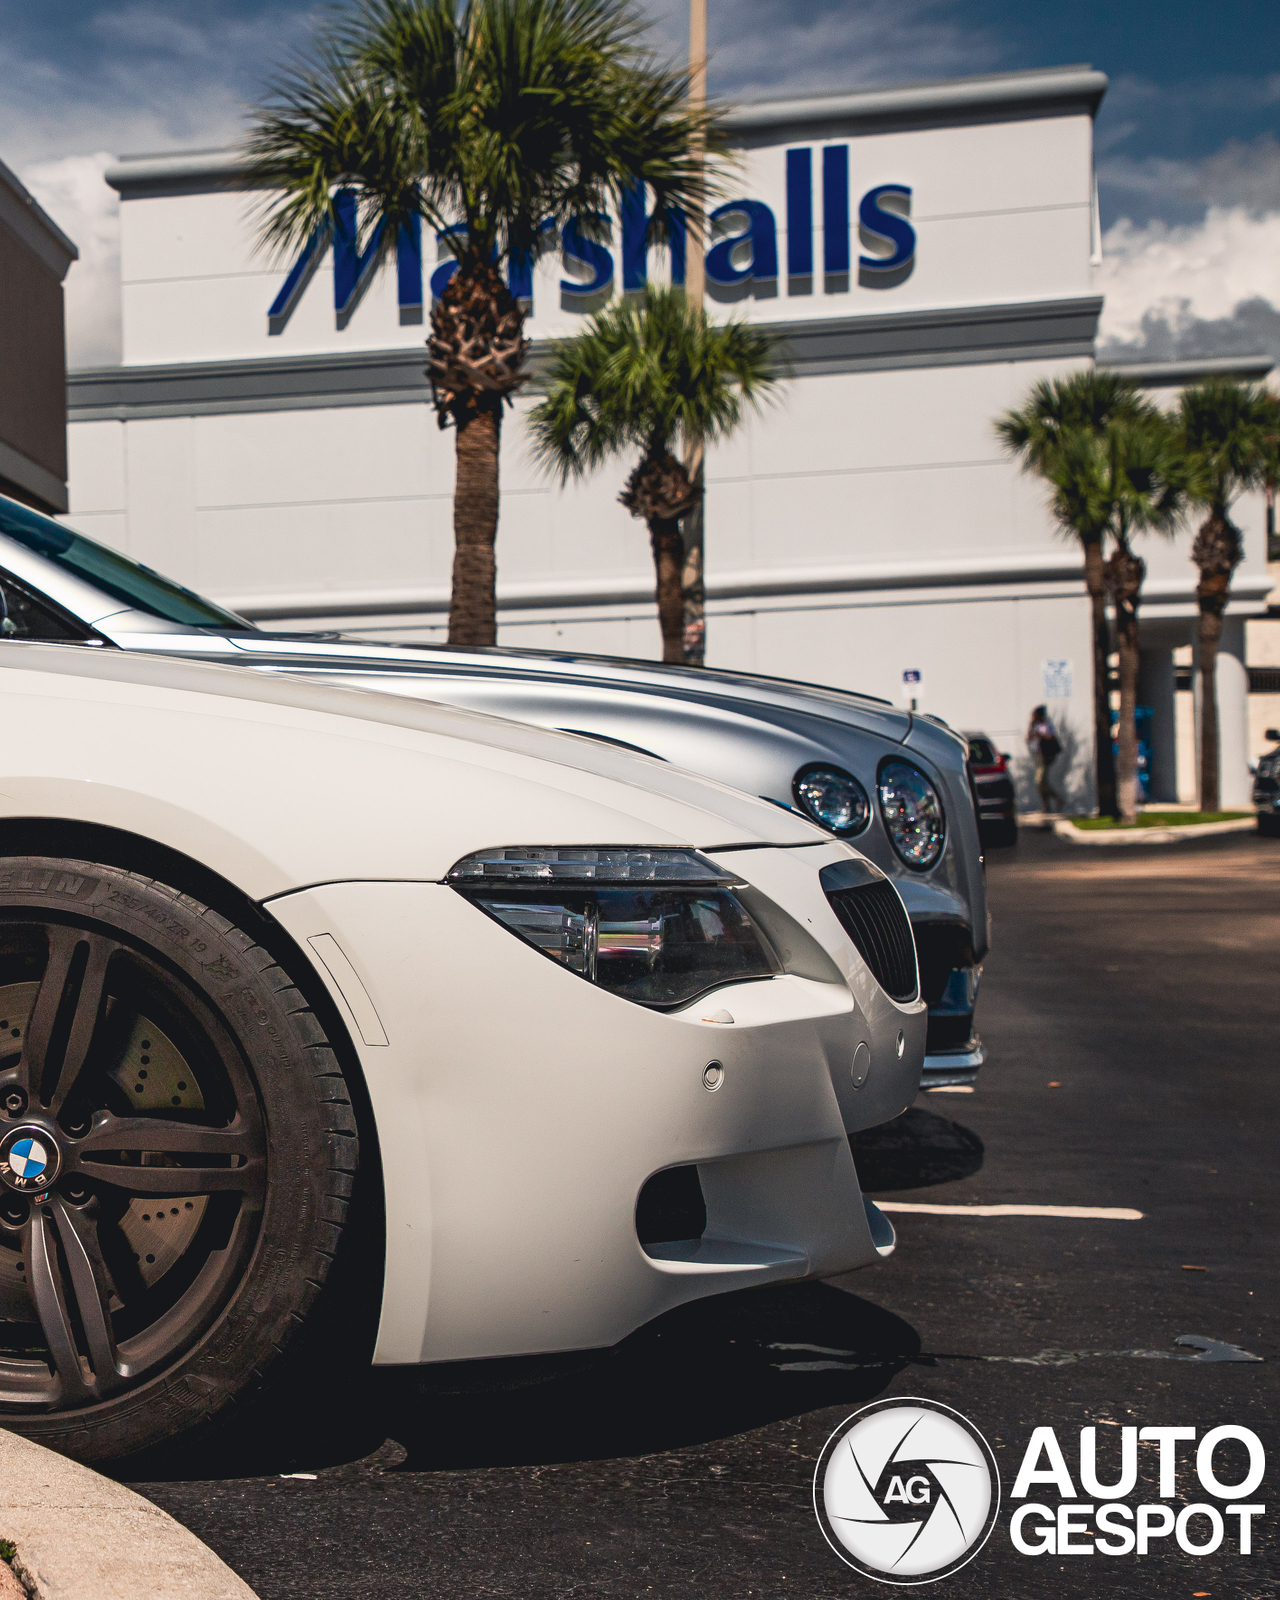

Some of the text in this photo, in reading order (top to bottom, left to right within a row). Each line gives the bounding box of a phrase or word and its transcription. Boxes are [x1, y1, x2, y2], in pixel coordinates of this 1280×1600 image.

[106, 889, 168, 925] 255/40
[188, 935, 209, 955] 19
[0, 1161, 48, 1188] BMW
